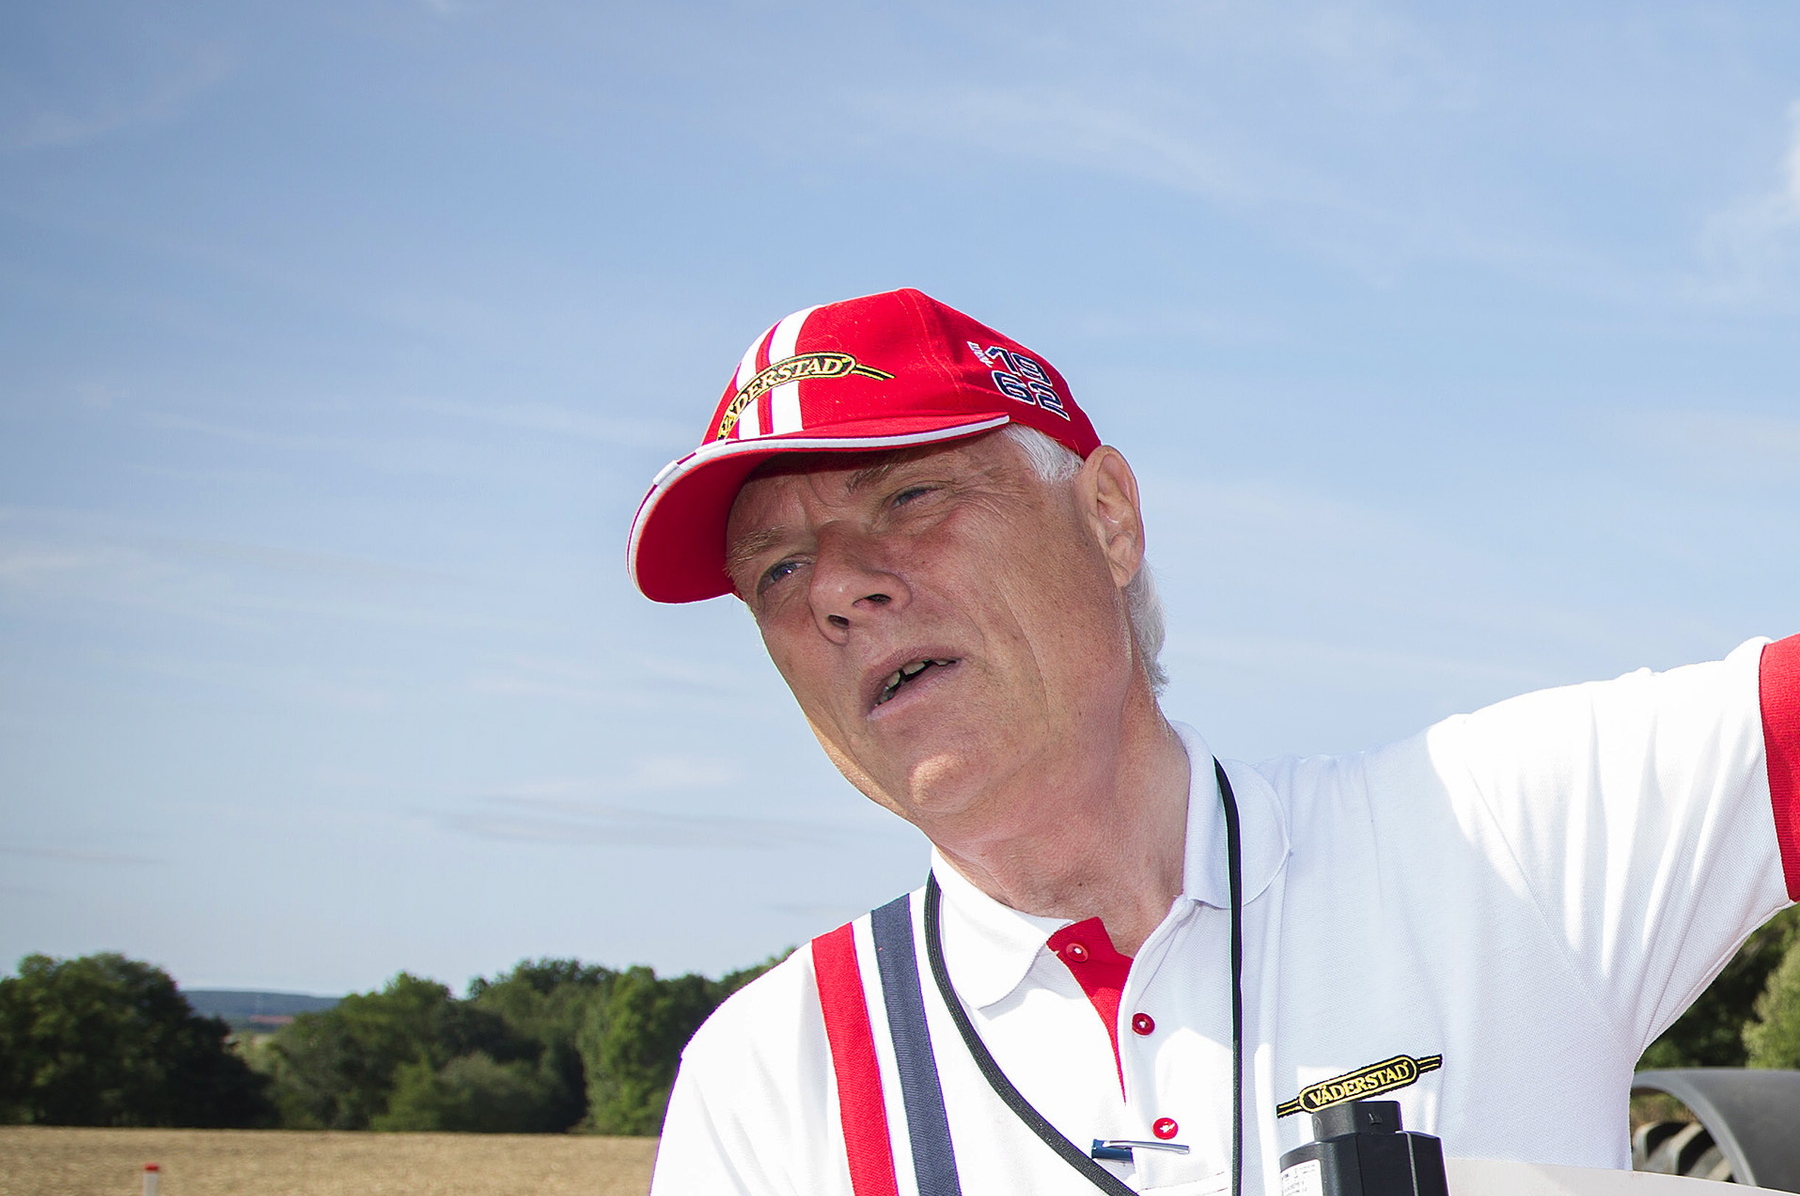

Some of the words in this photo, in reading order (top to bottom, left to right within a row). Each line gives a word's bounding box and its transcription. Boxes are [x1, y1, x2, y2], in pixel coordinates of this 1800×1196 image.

[985, 345, 1053, 387] 19
[991, 370, 1071, 422] 62
[1308, 1062, 1410, 1106] VÄDERSTAD
